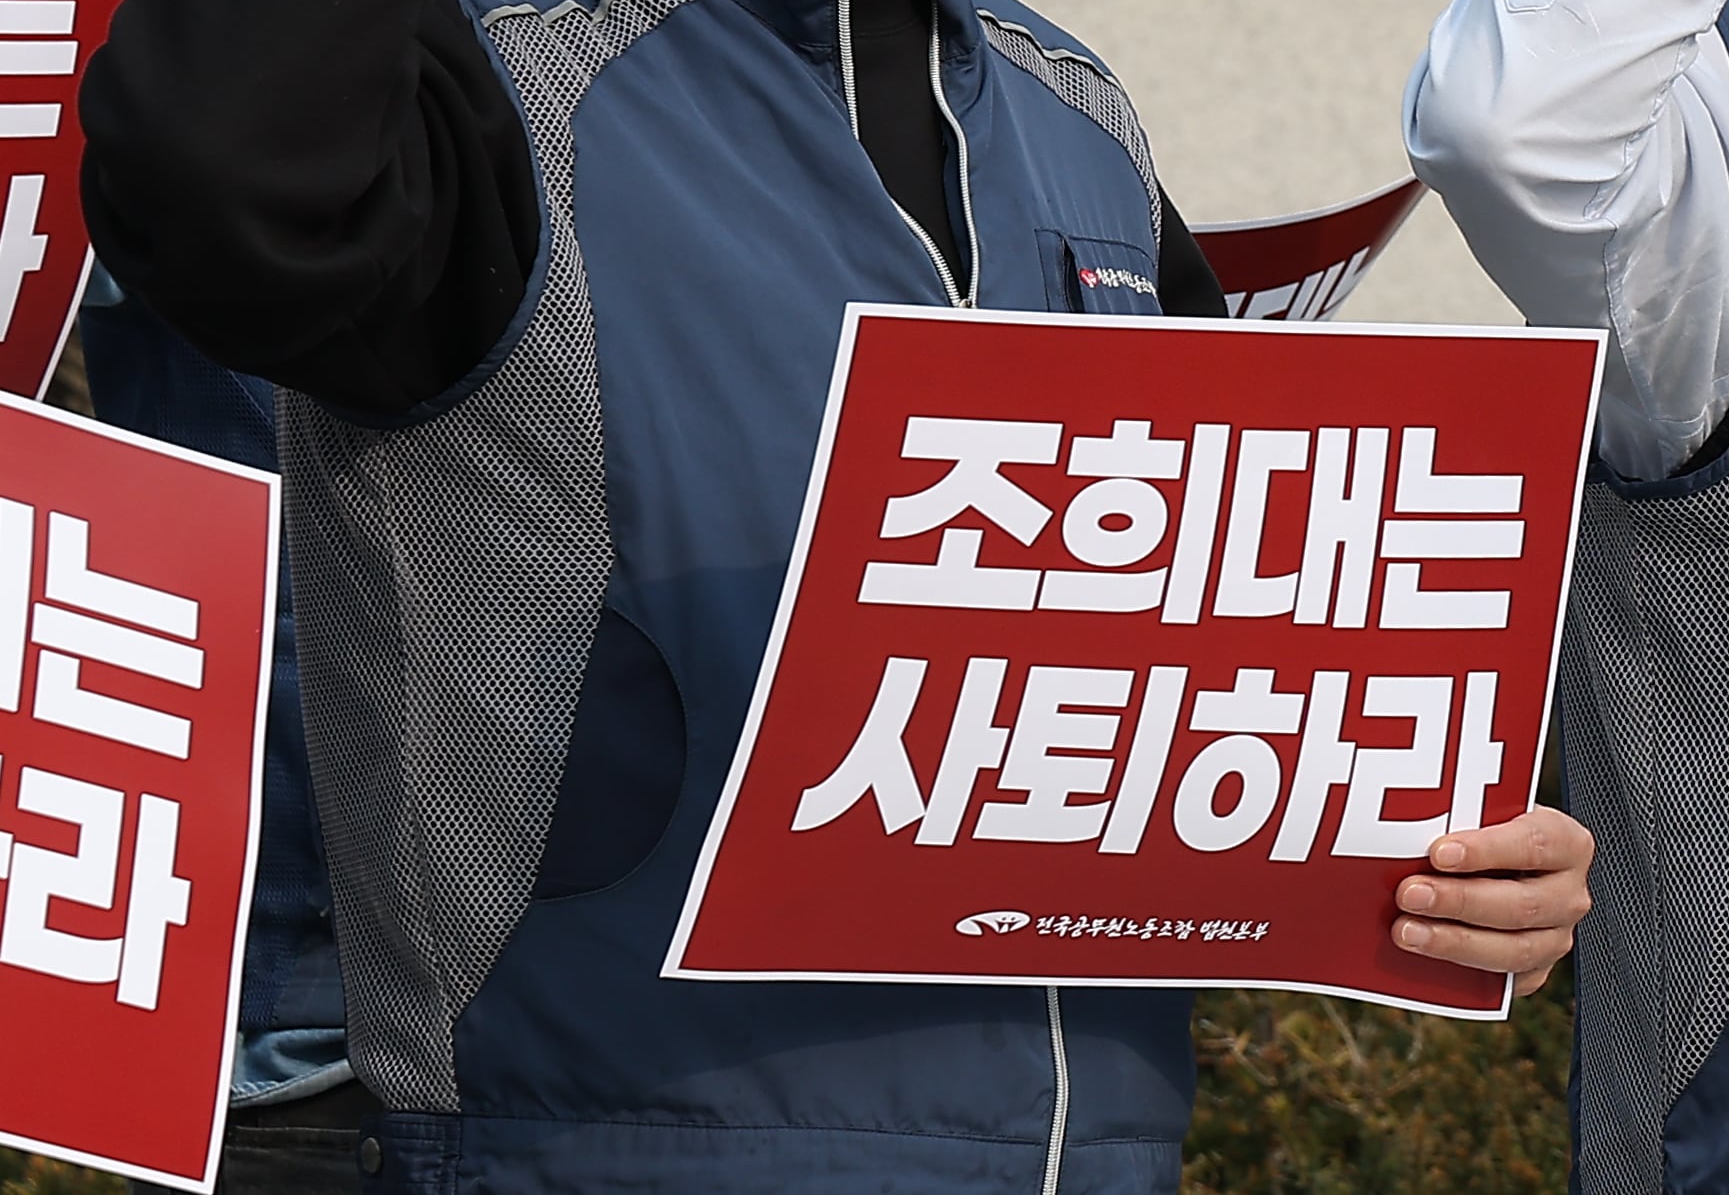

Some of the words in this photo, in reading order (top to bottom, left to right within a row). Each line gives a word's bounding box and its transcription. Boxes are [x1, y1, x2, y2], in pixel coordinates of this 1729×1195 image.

[857, 416, 1525, 629] 조희대는
[0, 496, 205, 760] 는
[790, 656, 1504, 863] 사퇴하라
[1037, 916, 1195, 939] 전국공무원노동조합
[1200, 921, 1268, 941] 법원본부
